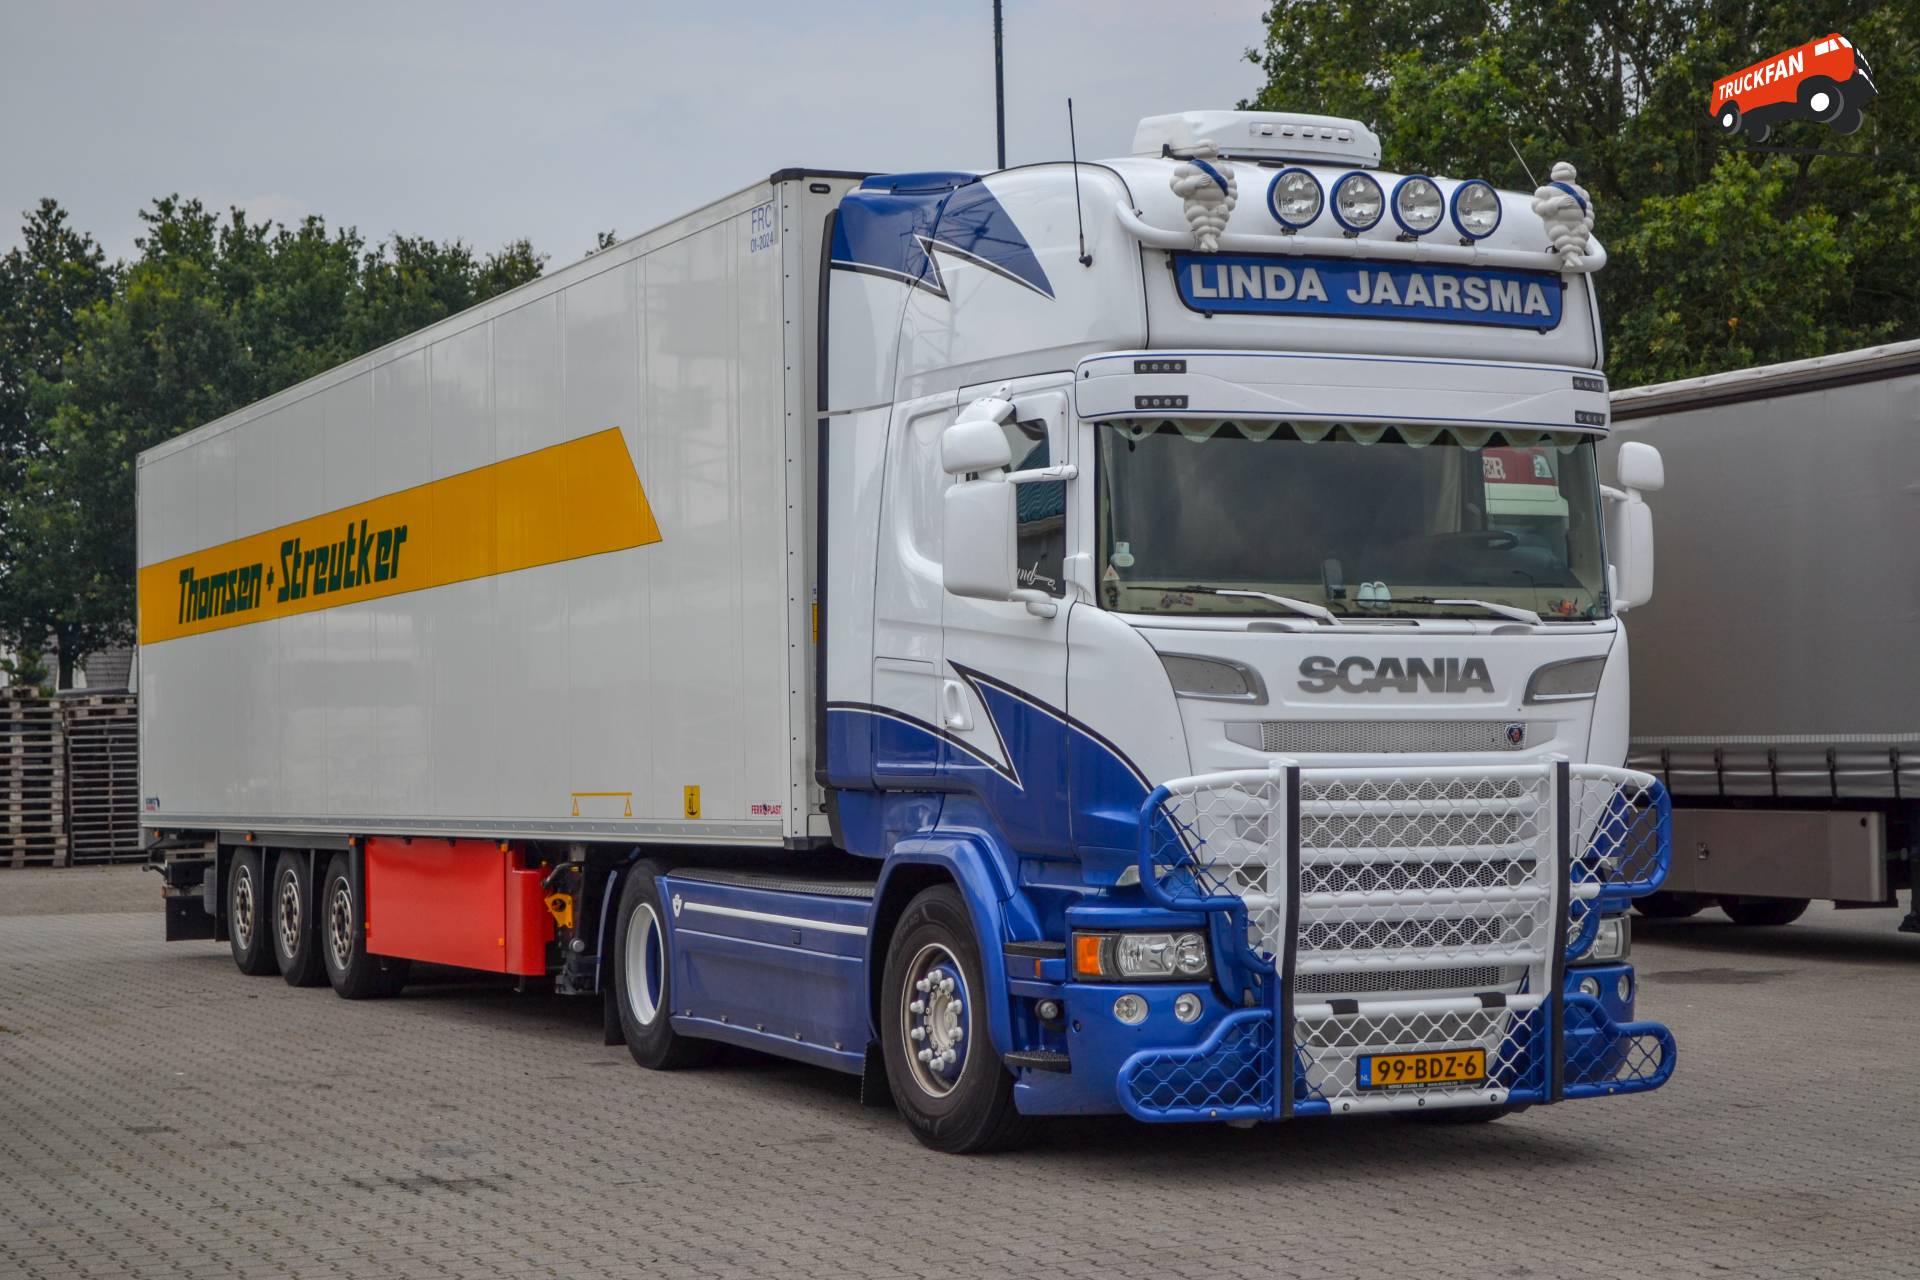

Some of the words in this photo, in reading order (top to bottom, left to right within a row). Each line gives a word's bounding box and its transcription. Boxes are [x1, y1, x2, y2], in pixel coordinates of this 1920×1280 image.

[751, 205, 772, 234] FRC
[1190, 263, 1329, 303] LINDA
[1346, 269, 1552, 317] JAARSMA
[178, 562, 263, 625] Thomsen
[277, 518, 408, 604] Streutker
[1297, 655, 1496, 694] SCANIA
[1360, 1074, 1370, 1082] NL
[1377, 1055, 1477, 1082] 99-BDZ-6
